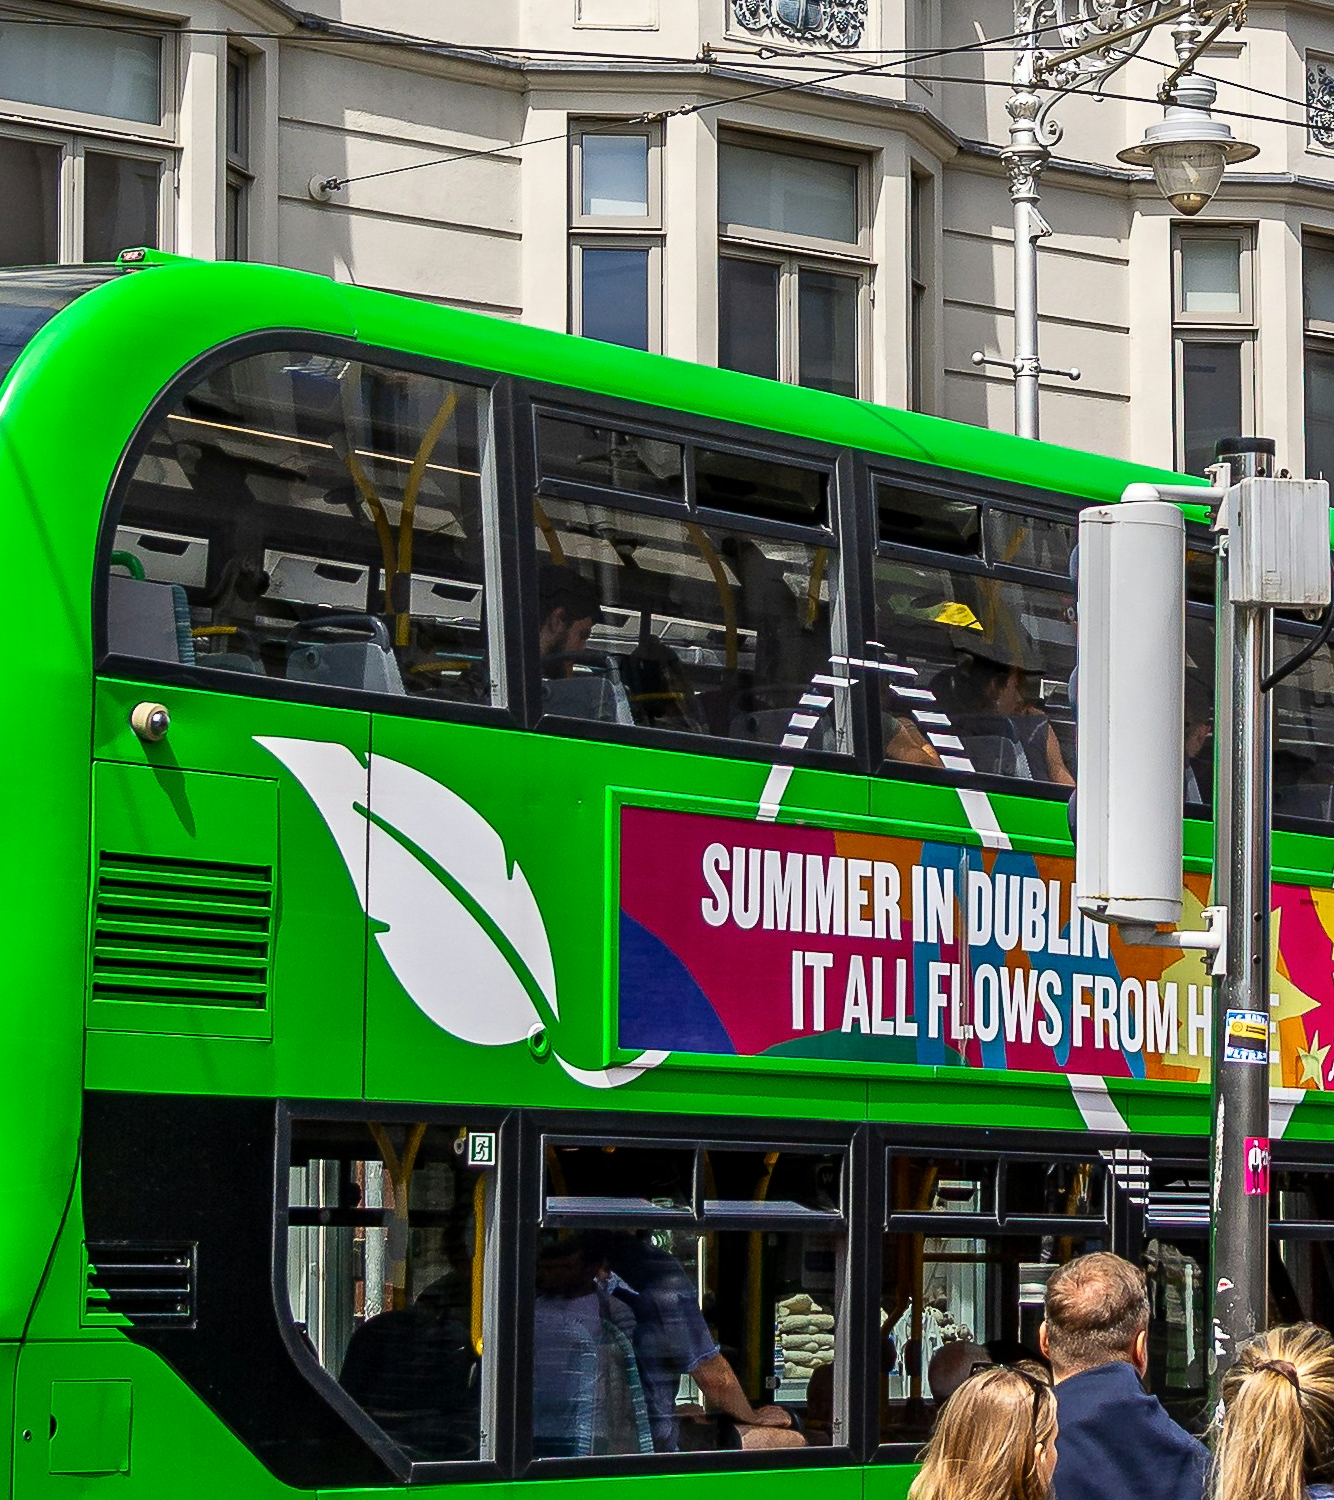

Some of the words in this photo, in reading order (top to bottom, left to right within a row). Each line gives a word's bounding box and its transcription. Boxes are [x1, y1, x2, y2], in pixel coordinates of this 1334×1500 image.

[701, 842, 902, 941] SUMMER
[912, 864, 955, 945] IN
[968, 869, 1110, 960] DUBLIN
[791, 949, 834, 1031] IT
[840, 954, 921, 1040] ALL
[928, 961, 1064, 1049] FLOWS
[1072, 973, 1180, 1057] FROM
